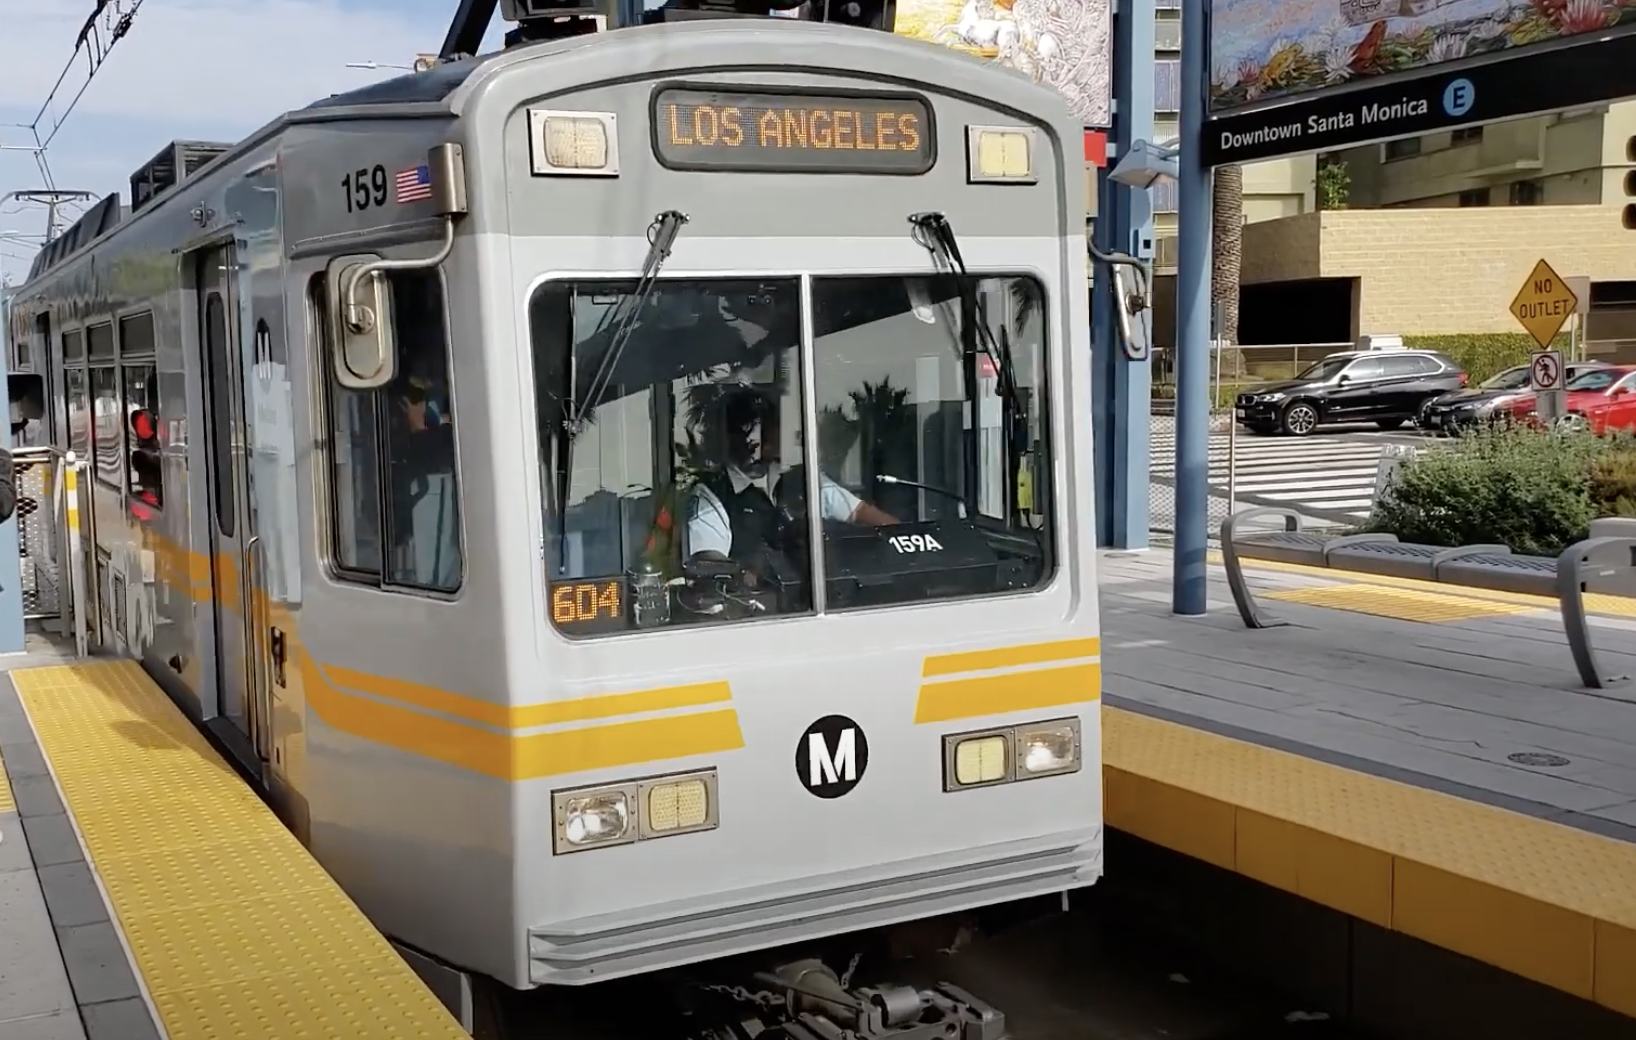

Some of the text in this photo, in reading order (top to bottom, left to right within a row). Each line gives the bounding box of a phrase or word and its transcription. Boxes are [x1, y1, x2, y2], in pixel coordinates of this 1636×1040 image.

[670, 104, 920, 150] LOS ANGELES
[1220, 85, 1467, 150] Downtown Santa Monica E
[341, 164, 387, 213] 159
[1534, 279, 1553, 294] NO
[1519, 299, 1569, 319] OUTLET
[888, 533, 944, 554] 159A
[553, 582, 620, 623] 604
[808, 727, 857, 787] M
